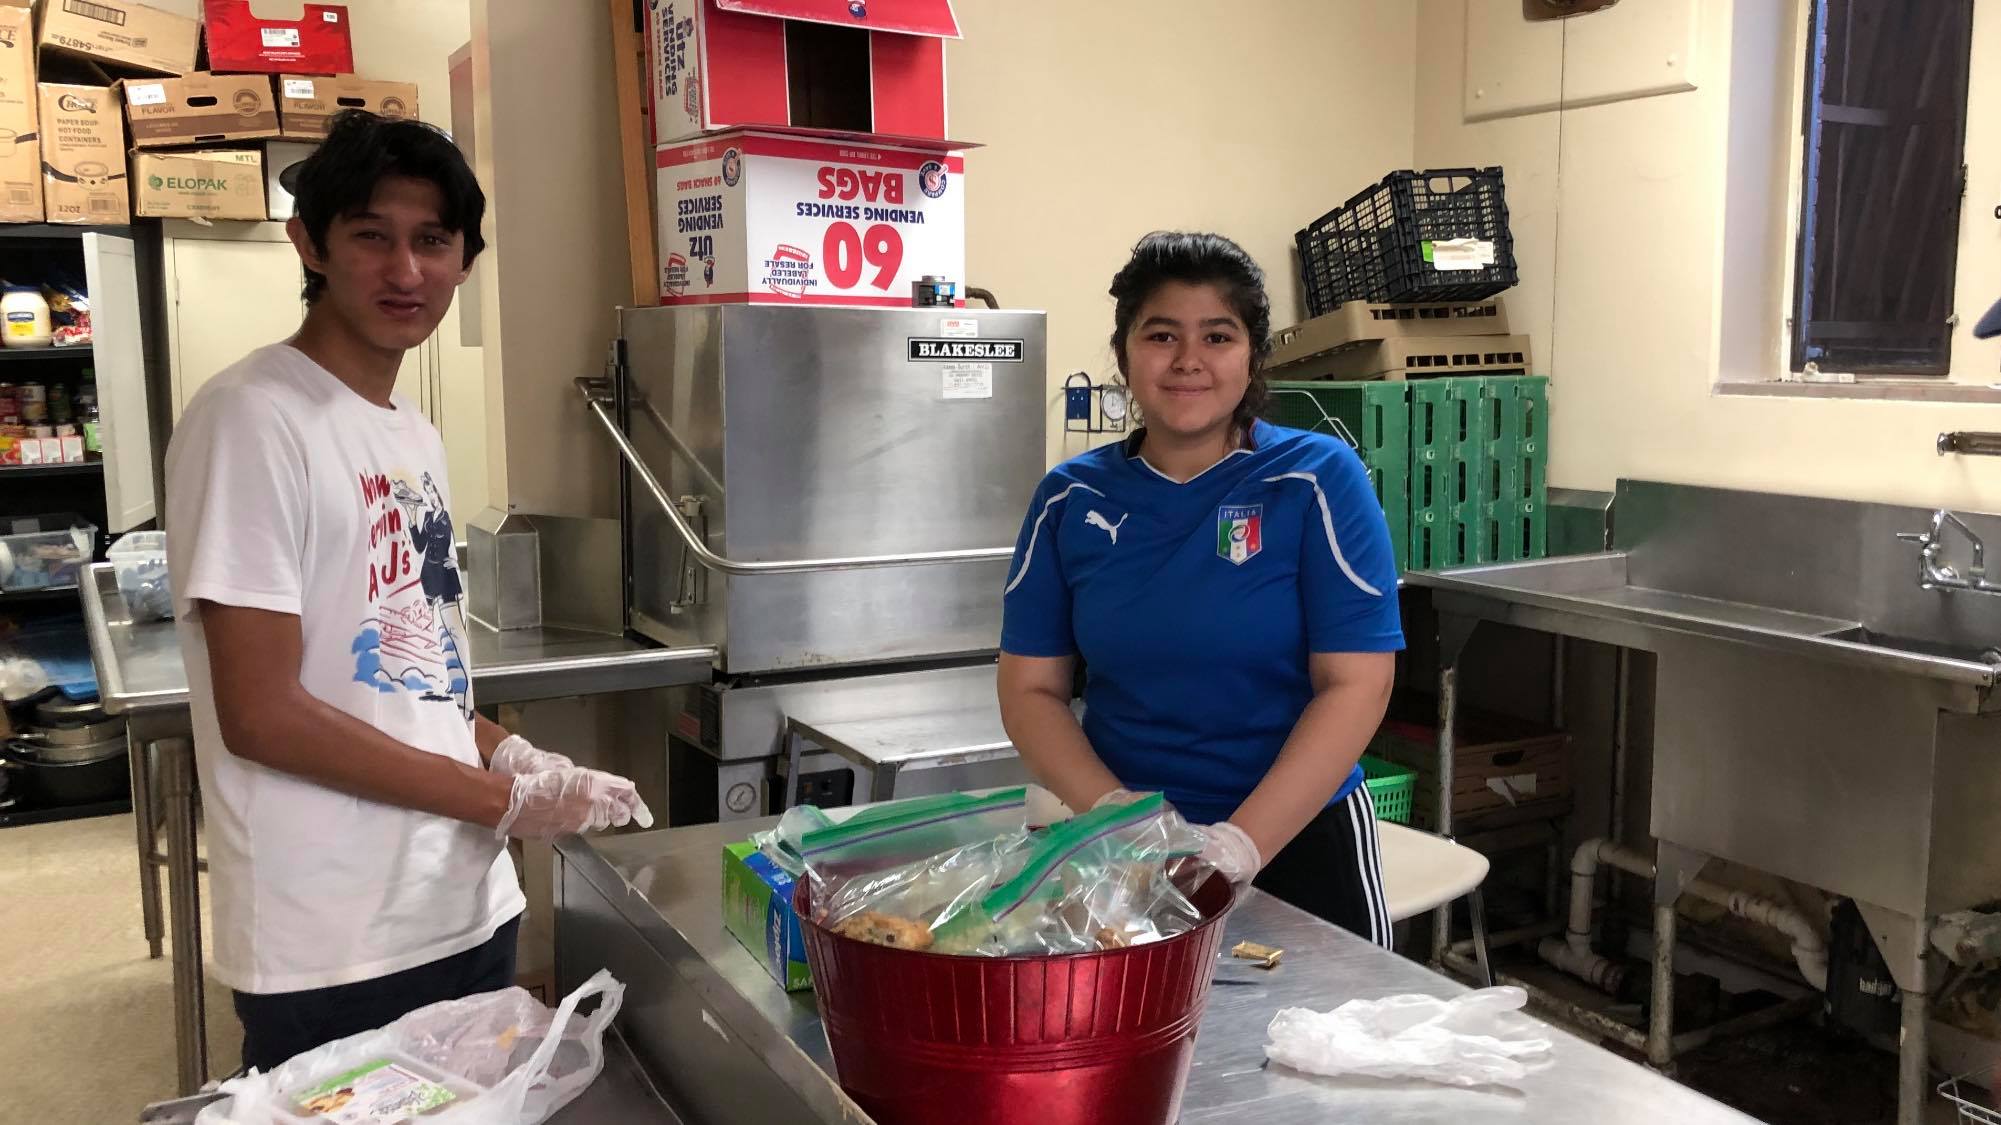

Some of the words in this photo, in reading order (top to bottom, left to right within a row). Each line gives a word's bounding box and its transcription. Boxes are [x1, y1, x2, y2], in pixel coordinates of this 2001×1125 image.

[661, 7, 672, 97] SERVICES
[667, 2, 678, 96] VENDING
[141, 106, 176, 115] FLAVOR
[57, 118, 79, 126] PAPER
[58, 135, 102, 144] CONTAINERS
[235, 154, 258, 163] MTL
[166, 177, 228, 191] ELOPAK
[816, 166, 904, 205] BAGS
[677, 194, 723, 216] SERVICES
[796, 202, 860, 221] SERVICES
[864, 206, 925, 224] VENDING
[677, 213, 724, 234] VENDING
[822, 221, 904, 292] 60
[764, 260, 796, 269] RESALE
[798, 262, 814, 270] FOR
[762, 277, 817, 287] INDIVIDUALLY
[918, 343, 1016, 357] BLAKESLEE
[1223, 510, 1257, 519] ITALIA
